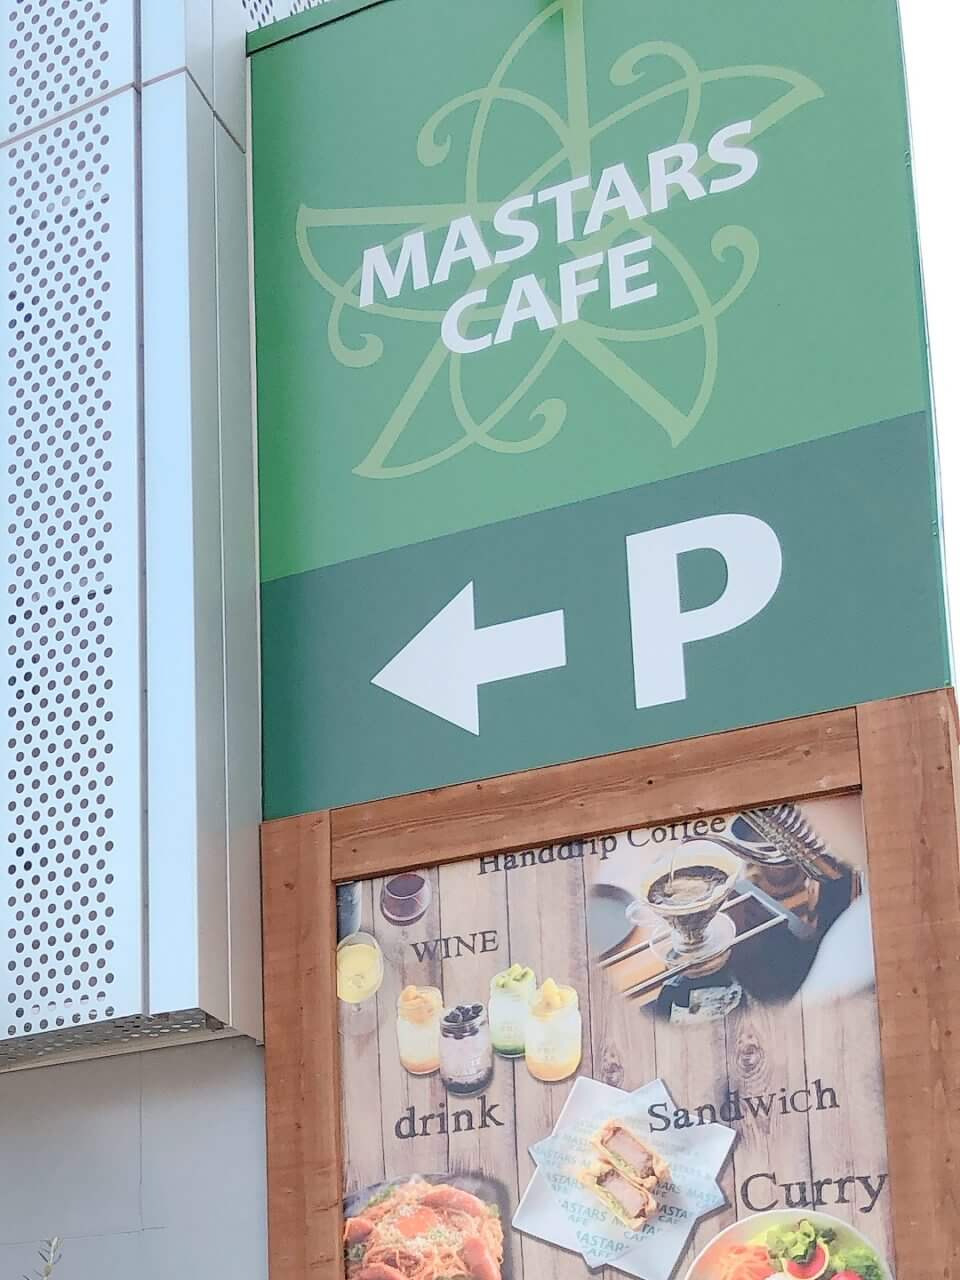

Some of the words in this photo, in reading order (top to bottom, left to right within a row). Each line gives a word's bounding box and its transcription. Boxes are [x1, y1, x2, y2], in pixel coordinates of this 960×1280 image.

[359, 119, 760, 308] MASTARS
[441, 237, 658, 354] CAFE
[626, 513, 783, 709] P
[477, 833, 618, 876] Handdrip
[410, 930, 500, 964] WINE
[394, 1096, 505, 1140] drink
[647, 1078, 841, 1134] Sandwich
[740, 1172, 889, 1213] Curry
